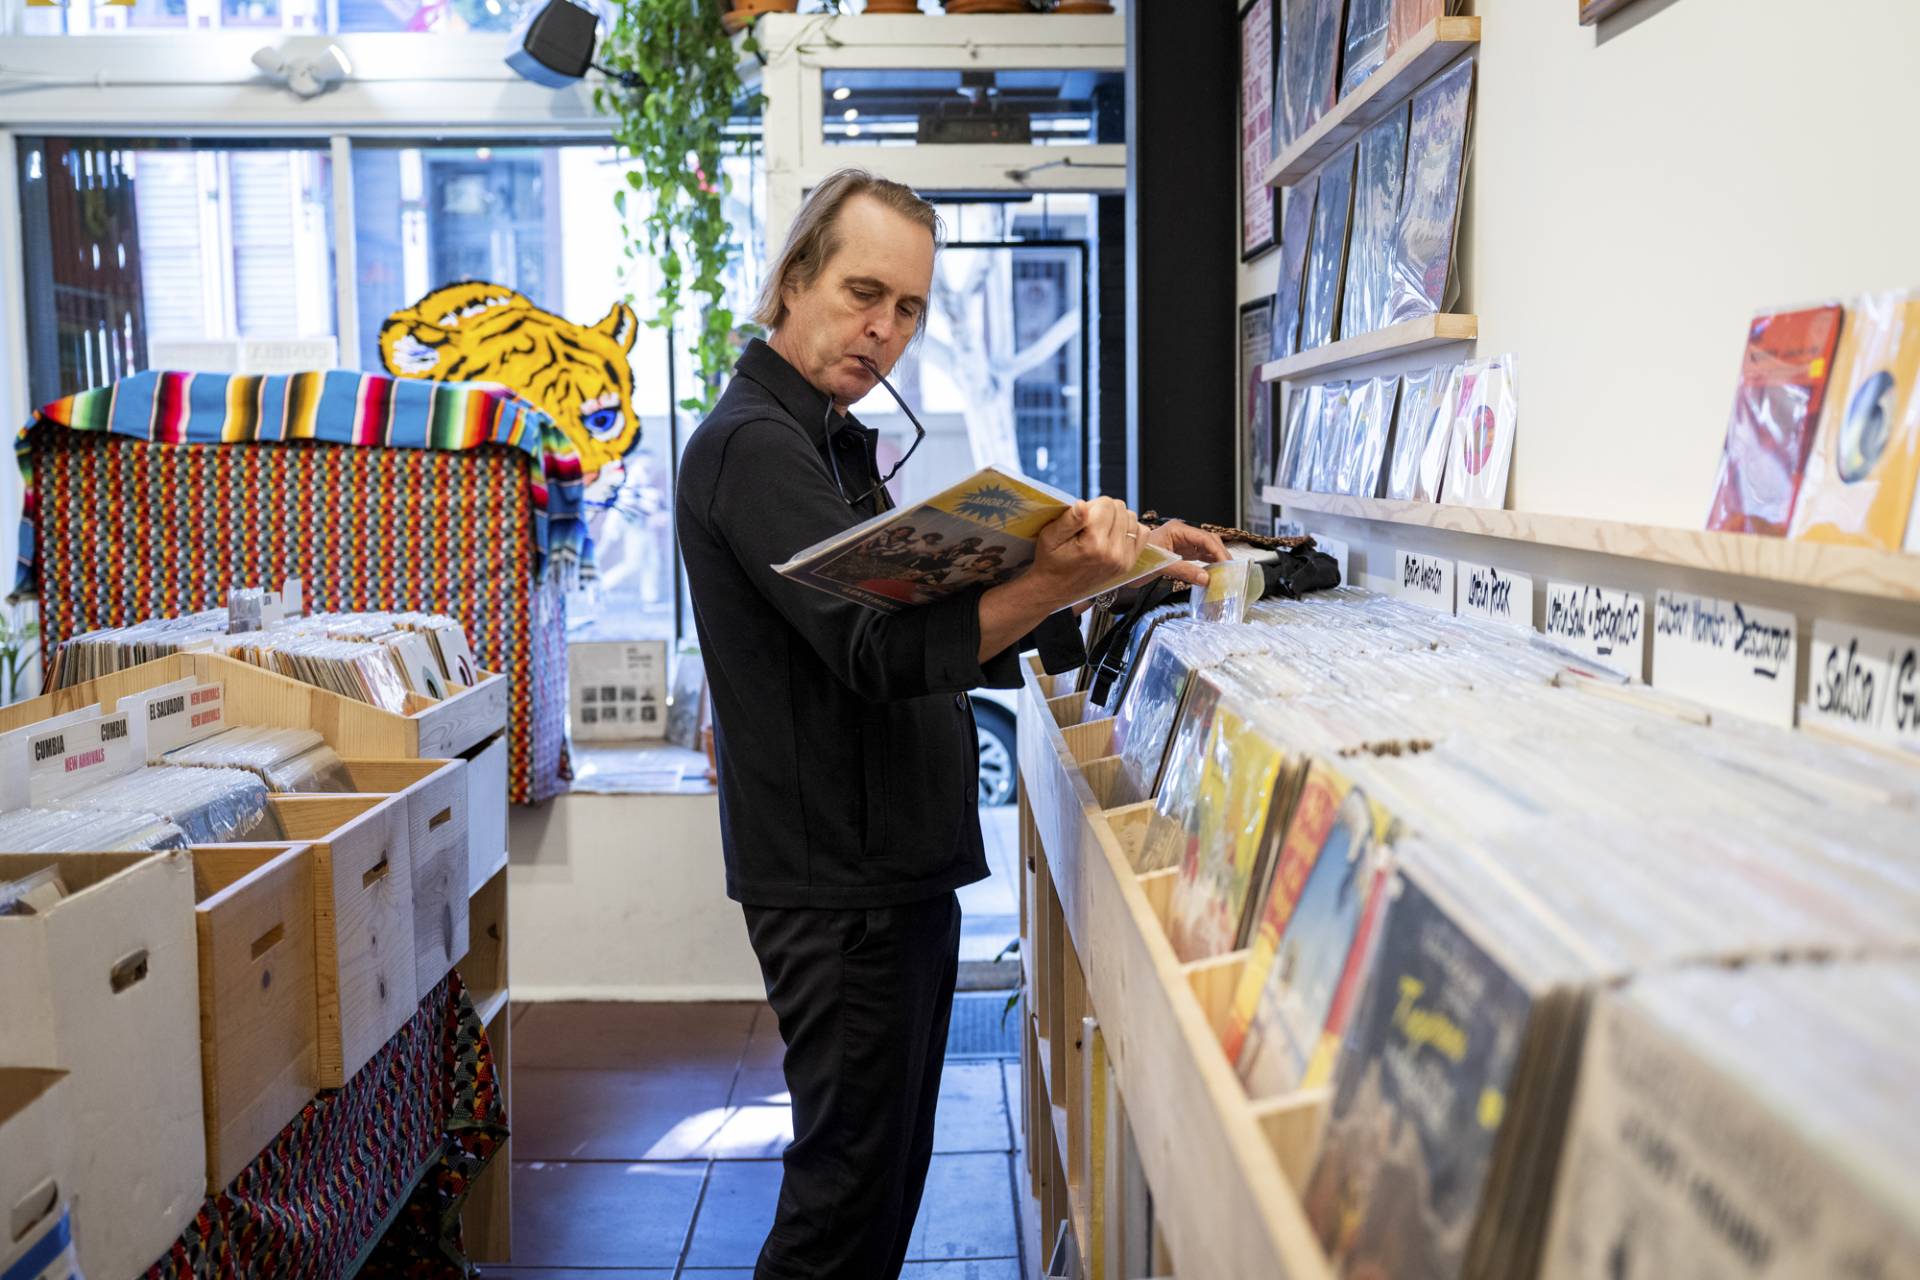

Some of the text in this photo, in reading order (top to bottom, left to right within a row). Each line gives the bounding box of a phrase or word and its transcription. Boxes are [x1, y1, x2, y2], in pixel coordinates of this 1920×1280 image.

[1468, 567, 1512, 617] Latin Rock
[1568, 585, 1589, 639] Soul
[1816, 637, 1875, 723] Salsa
[149, 696, 185, 721] EL SALVADOR
[101, 719, 128, 742] CUMBIA
[35, 735, 65, 761] CUMBIA
[65, 748, 105, 773] NEW ARRIVALS
